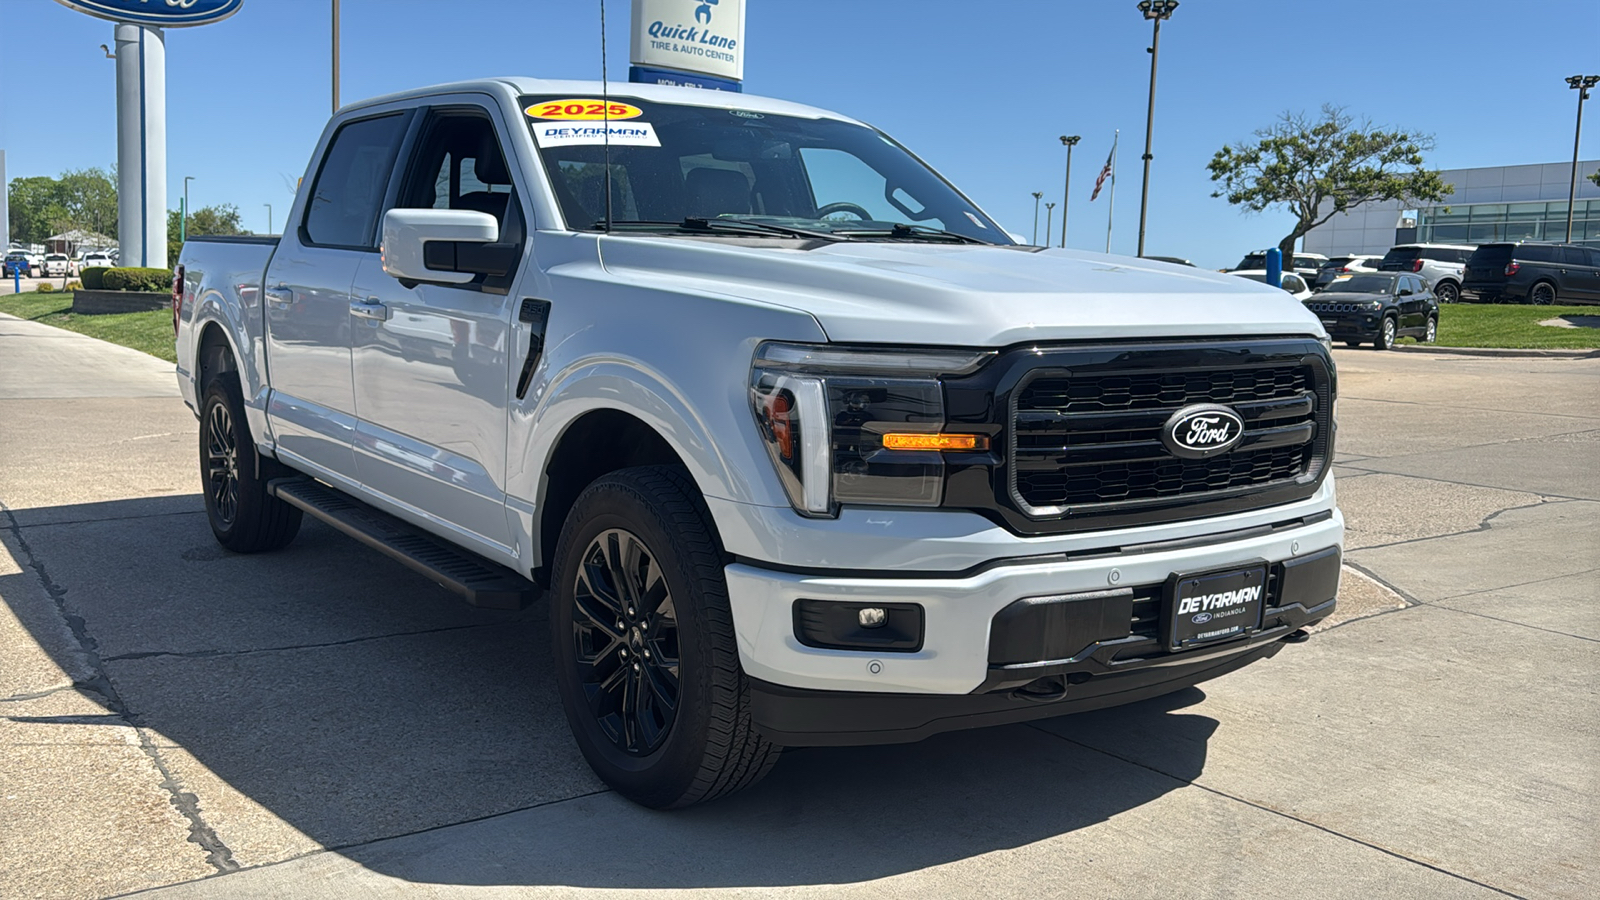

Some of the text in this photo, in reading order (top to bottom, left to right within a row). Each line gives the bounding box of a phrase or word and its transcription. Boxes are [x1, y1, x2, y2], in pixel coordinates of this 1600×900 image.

[648, 21, 736, 49] Quick Lane
[650, 40, 735, 63] TIRE & AUTO CENTER
[541, 104, 628, 116] 2025
[544, 127, 647, 137] DEYARMAN
[1186, 417, 1230, 445] Ford
[1177, 585, 1262, 615] DEYARMAN
[1213, 607, 1246, 619] INDIANOLA
[1197, 626, 1239, 639] DEYARMANFORD.COM
